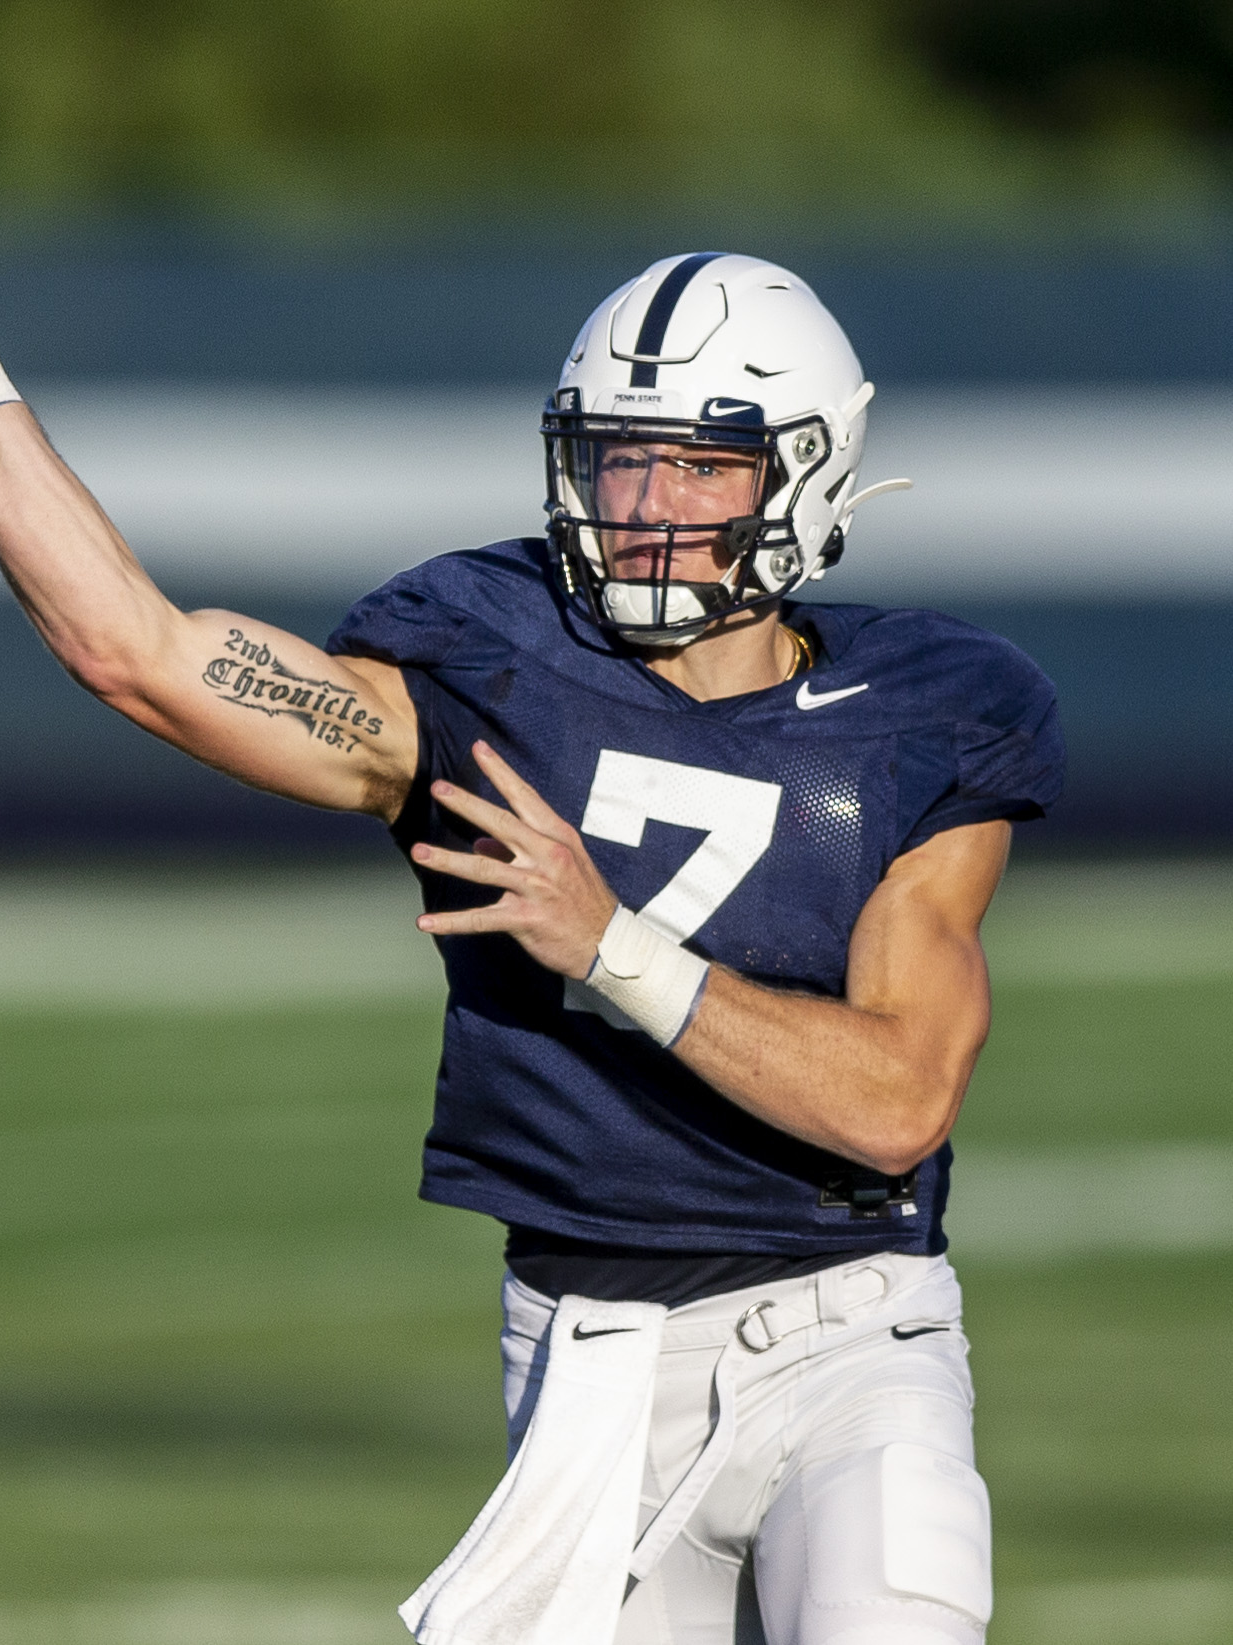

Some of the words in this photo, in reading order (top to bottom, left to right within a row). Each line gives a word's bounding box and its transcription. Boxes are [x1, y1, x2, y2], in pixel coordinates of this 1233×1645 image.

[225, 628, 271, 667] 2nd
[202, 658, 384, 736] Chronicles
[317, 720, 363, 753] 15:7
[563, 748, 783, 1031] 7
